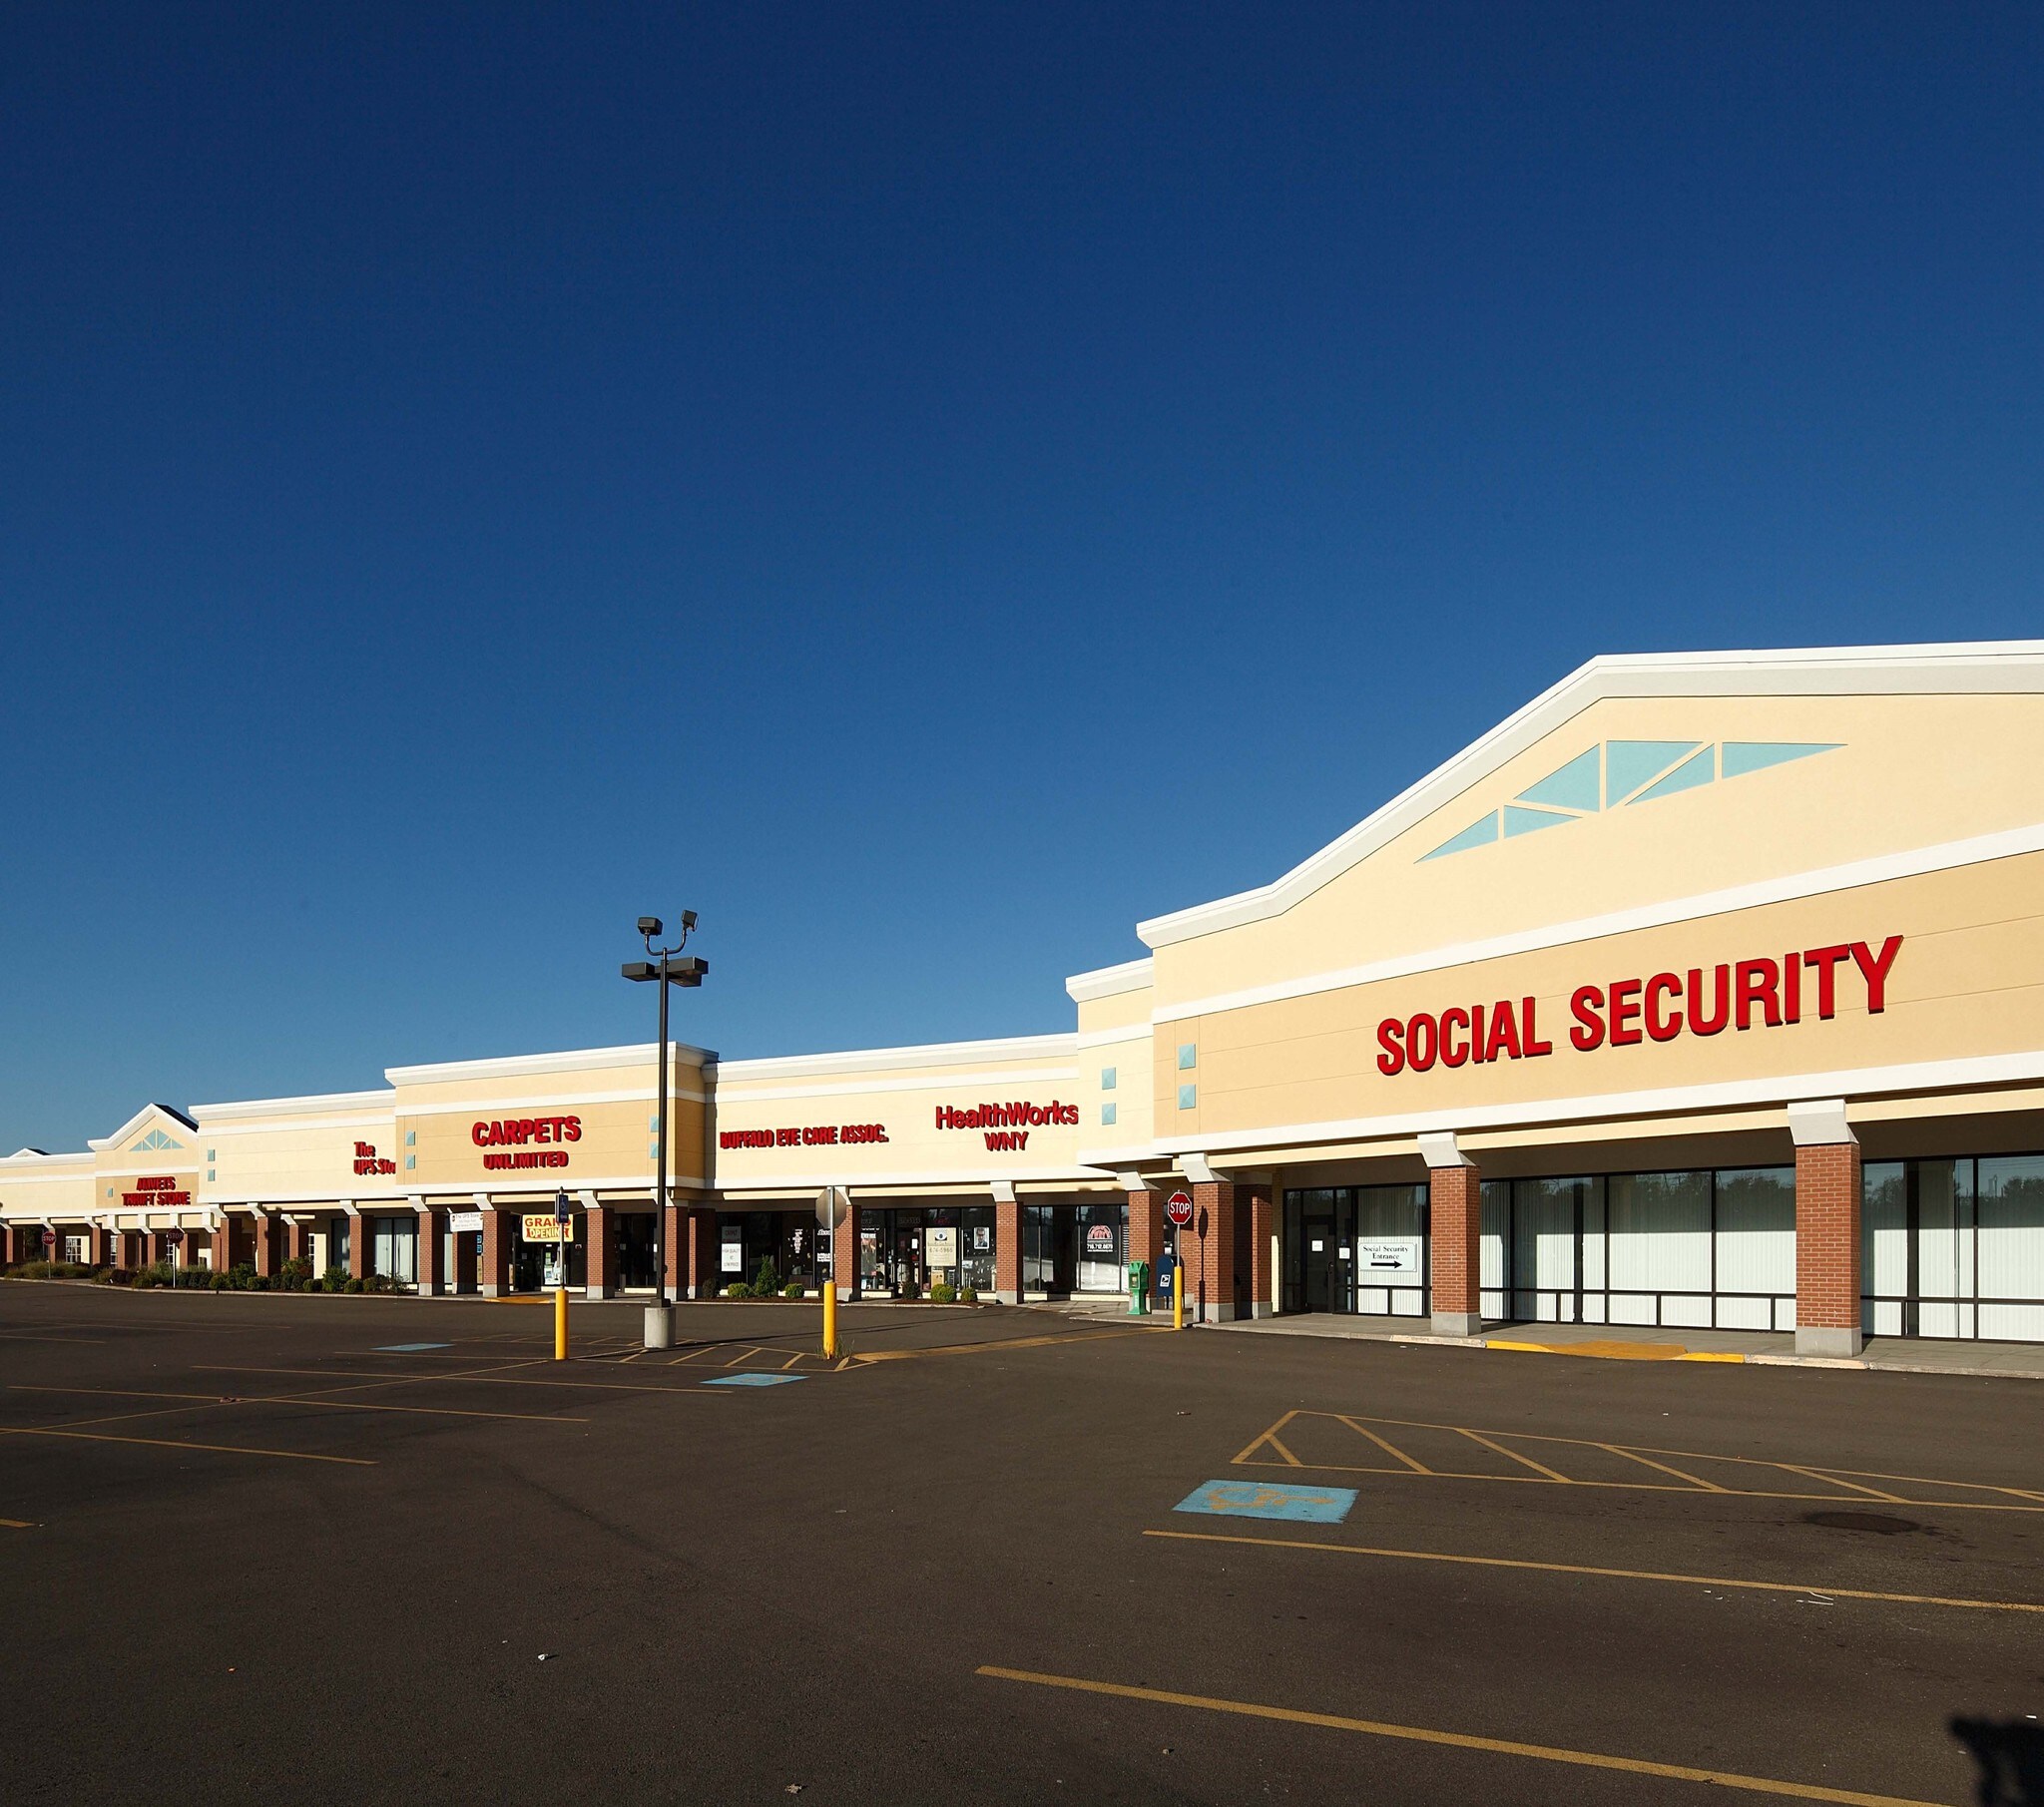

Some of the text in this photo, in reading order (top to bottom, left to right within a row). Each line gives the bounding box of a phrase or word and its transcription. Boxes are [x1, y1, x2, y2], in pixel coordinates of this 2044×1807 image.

[1376, 935, 1904, 1077] SOCIAL SECURITY
[936, 1100, 1079, 1129] HealthWorks
[472, 1116, 582, 1146] CARPETS
[720, 1124, 889, 1149] BUFFALO EYE CARE ASSOC.
[984, 1130, 1029, 1151] WNY
[353, 1141, 376, 1157] The
[353, 1157, 396, 1175] UPS Sto
[483, 1150, 570, 1170] UNLIMITED
[136, 1176, 177, 1191] AMVETS
[122, 1191, 191, 1206] THRIFT STORE
[1170, 1201, 1190, 1214] STOP
[529, 1227, 565, 1238] OPENIN
